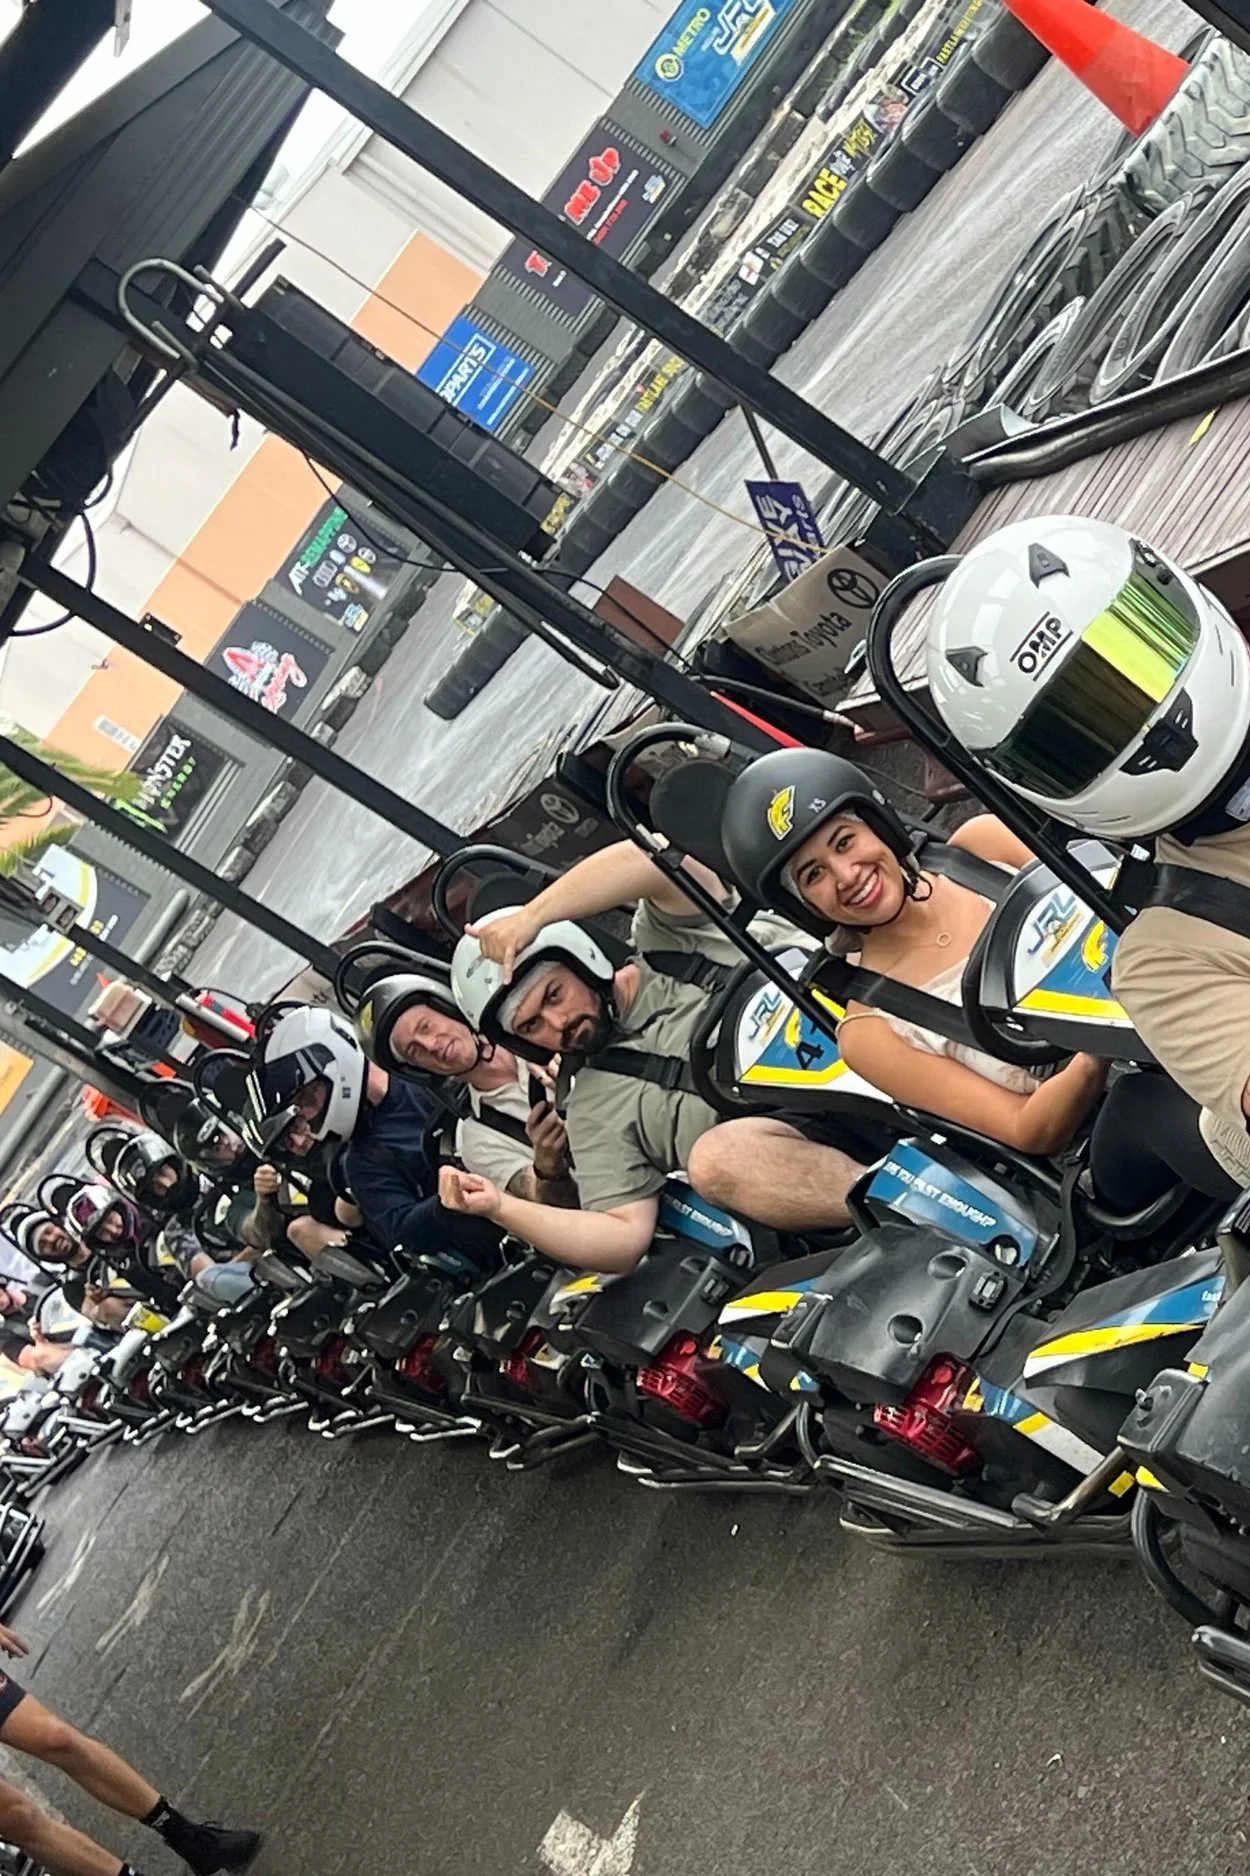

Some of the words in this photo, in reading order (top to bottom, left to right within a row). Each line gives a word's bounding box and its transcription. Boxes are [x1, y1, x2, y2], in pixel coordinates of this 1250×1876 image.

[672, 8, 711, 57] METRO
[564, 179, 601, 225] ME
[589, 147, 621, 186] UP
[802, 167, 847, 218] RACE
[1018, 617, 1062, 674] OMP
[132, 732, 192, 811] MONSTER
[159, 755, 197, 810] ENERGY
[1027, 891, 1078, 956] JRL
[748, 990, 783, 1041] JRL
[938, 1190, 996, 1229] ENOUGH?
